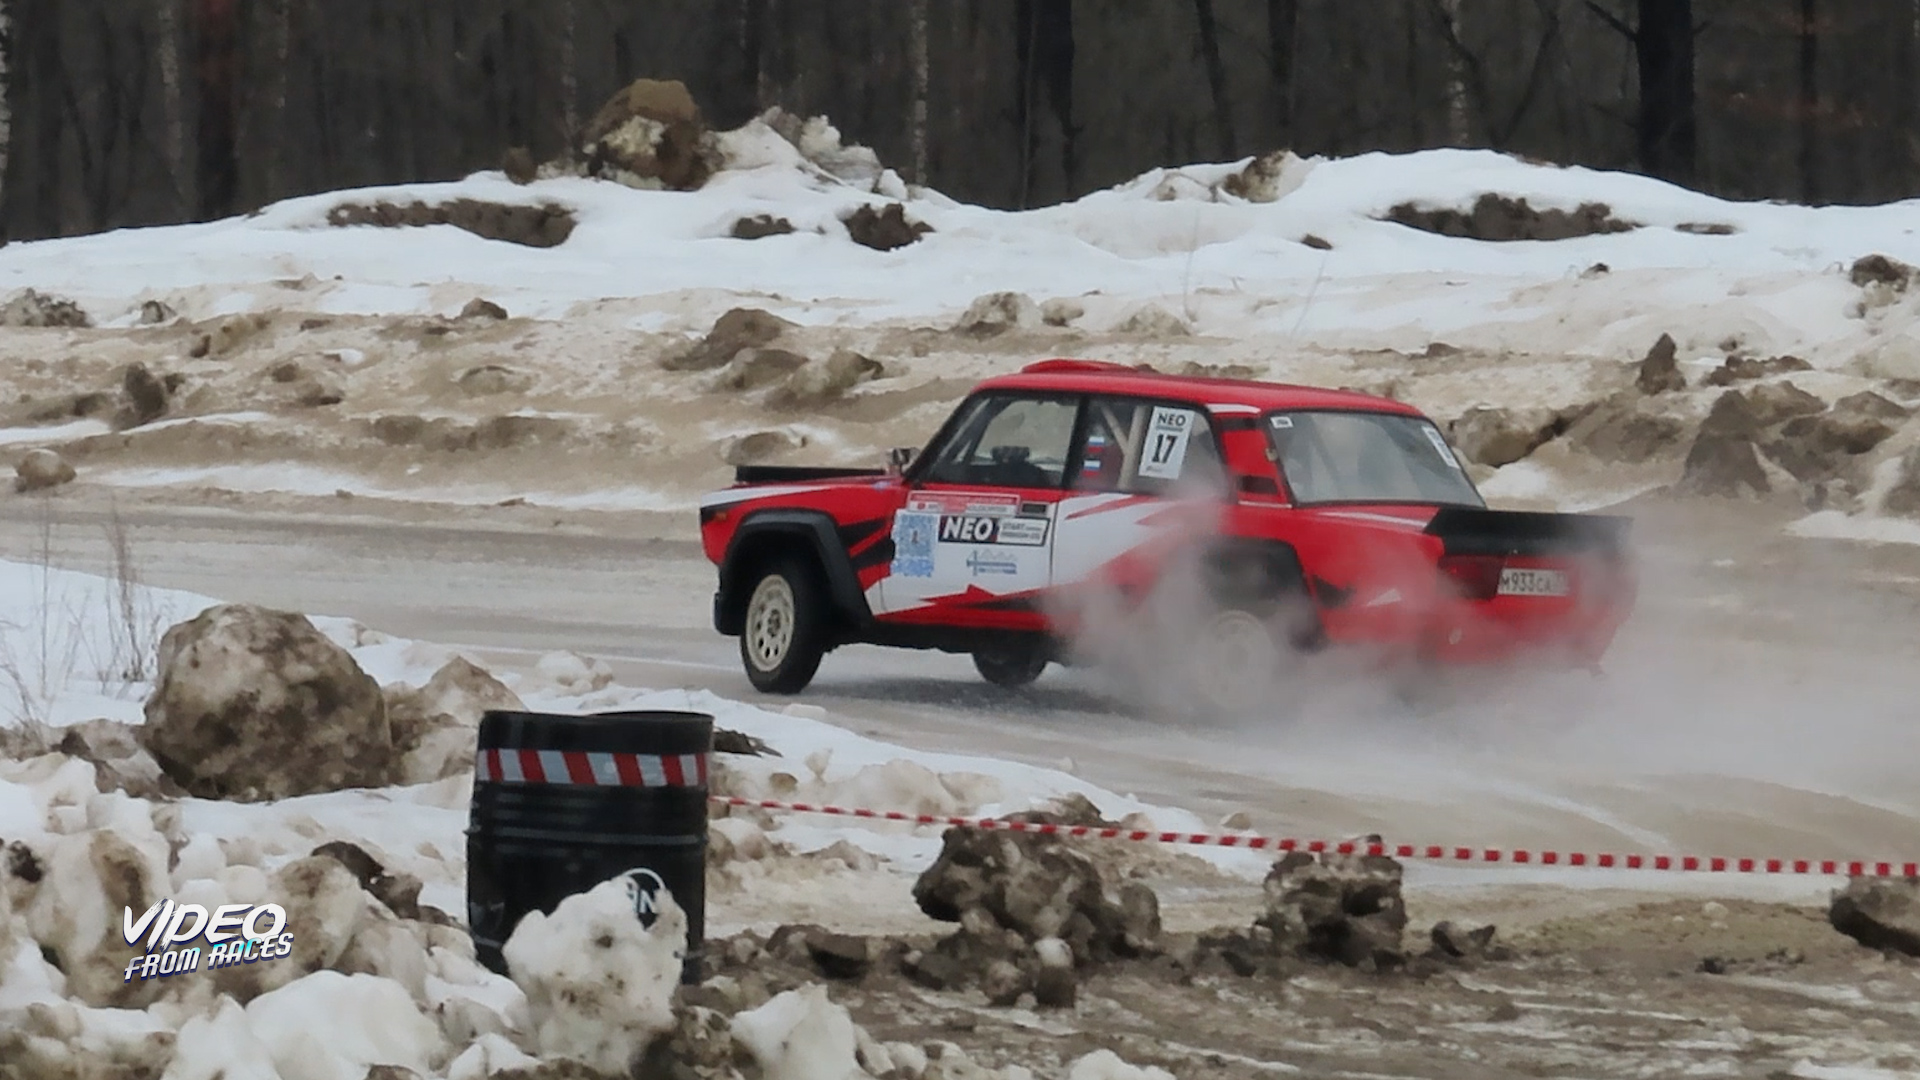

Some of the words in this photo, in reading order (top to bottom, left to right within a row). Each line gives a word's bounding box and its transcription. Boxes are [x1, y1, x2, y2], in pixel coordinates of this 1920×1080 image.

[1158, 413, 1186, 427] NEO
[1152, 434, 1178, 464] 17
[943, 515, 993, 541] NEO
